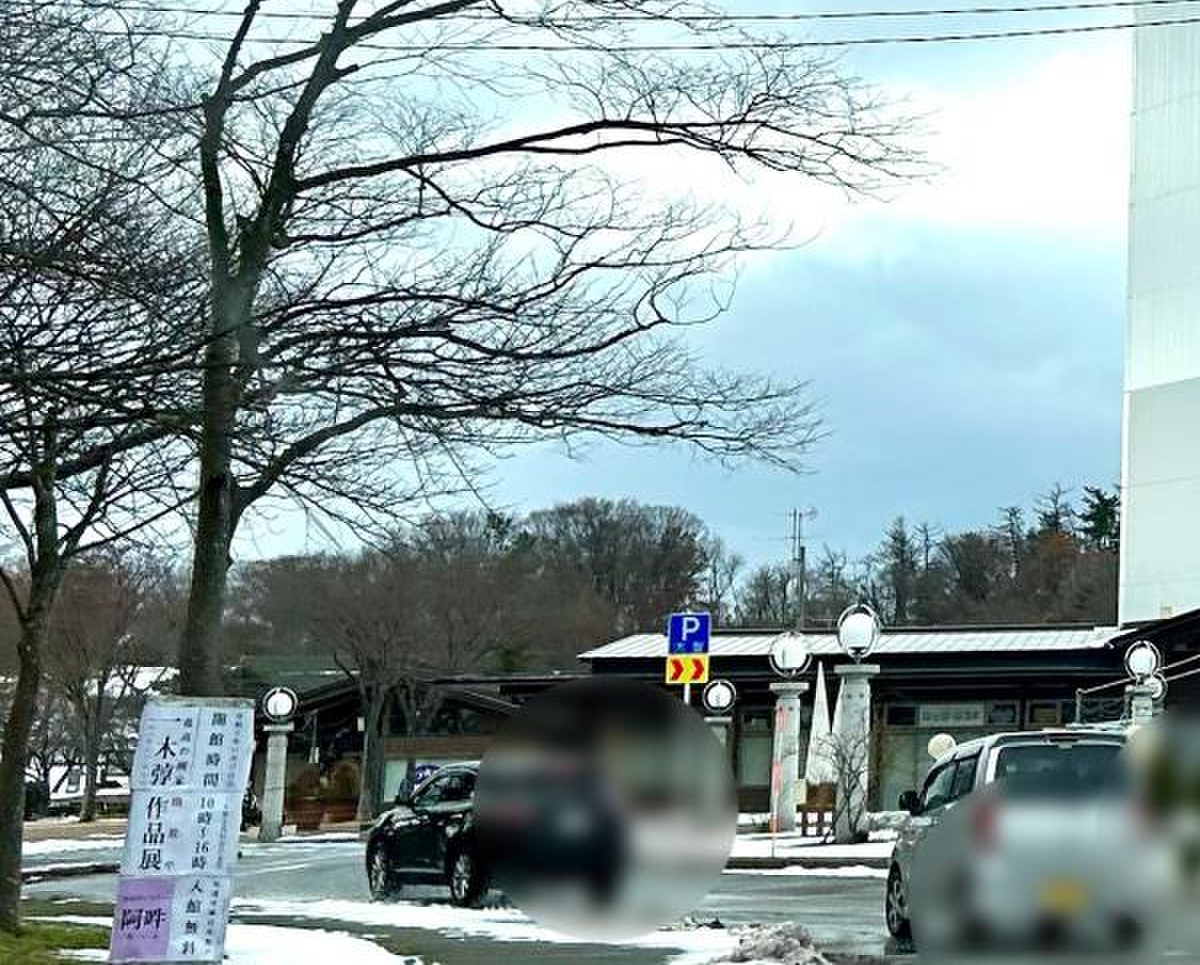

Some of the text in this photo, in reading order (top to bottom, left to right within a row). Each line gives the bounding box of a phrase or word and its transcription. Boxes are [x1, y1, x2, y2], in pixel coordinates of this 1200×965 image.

[681, 617, 701, 641] P
[203, 712, 228, 788] 開館時間
[139, 795, 169, 871] 作品展
[180, 879, 205, 956] 入館無料
